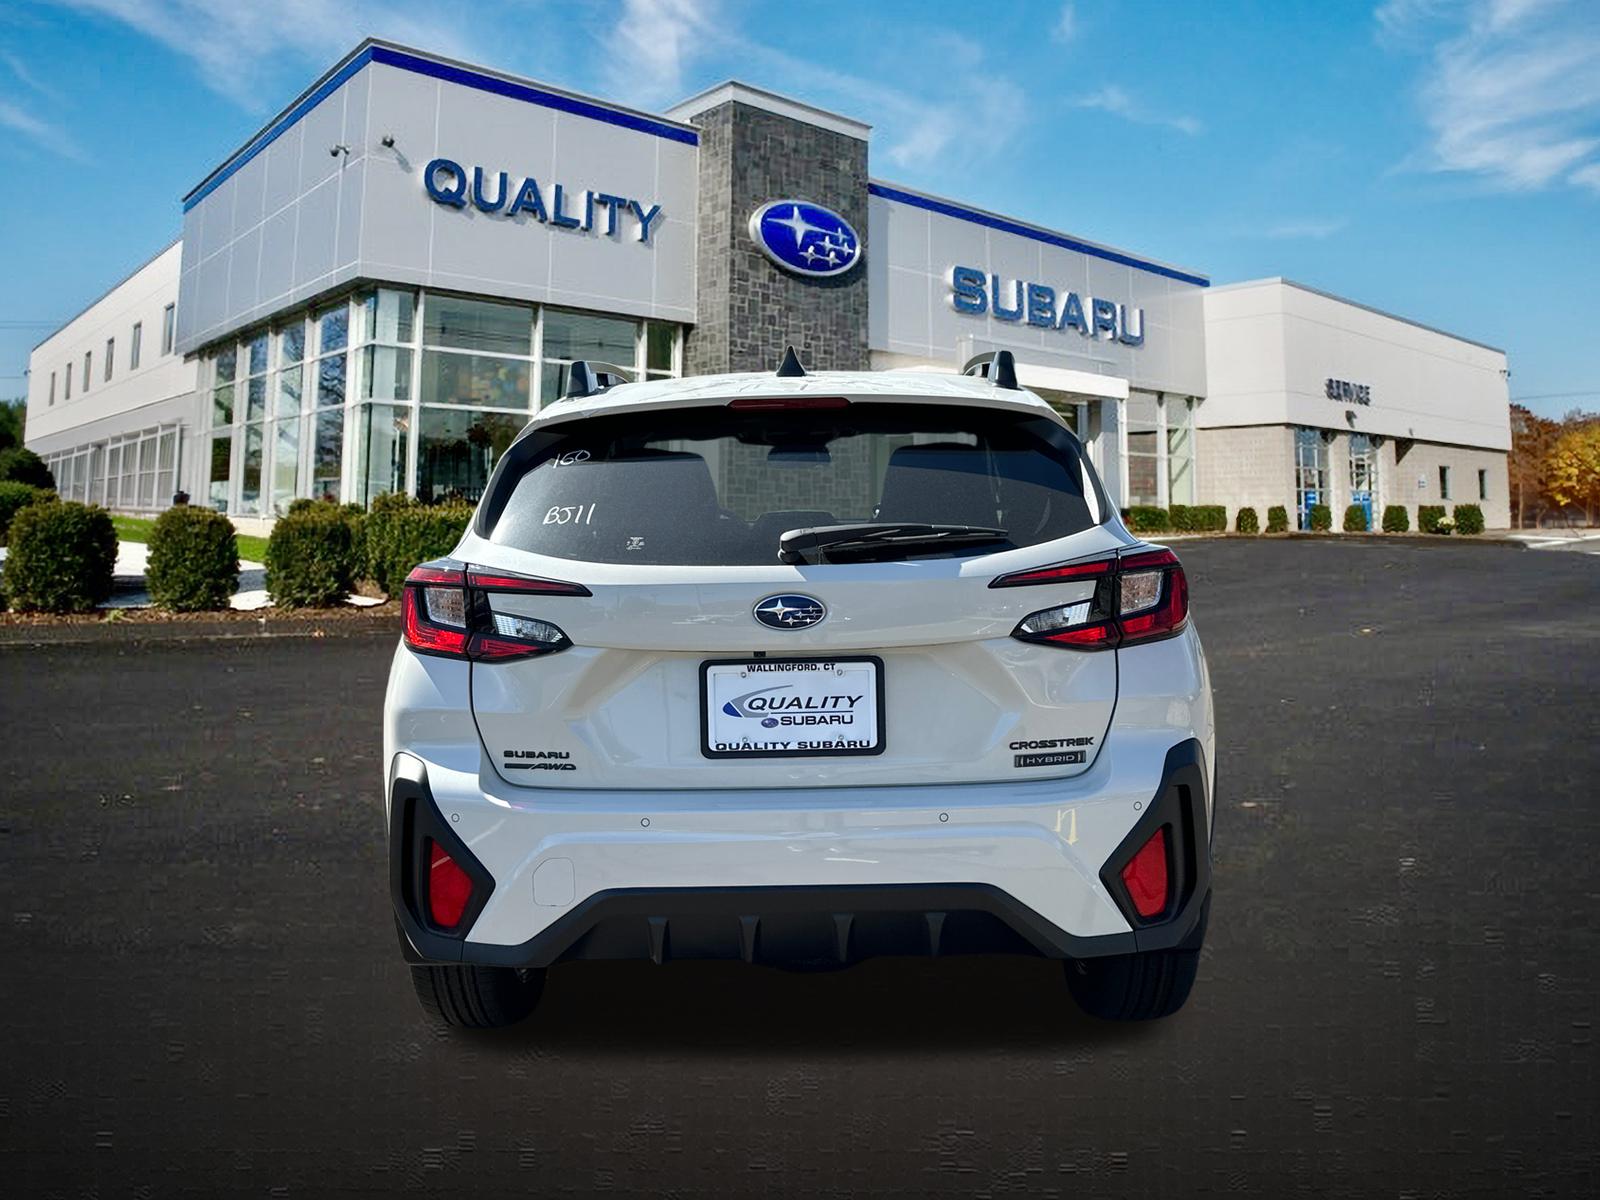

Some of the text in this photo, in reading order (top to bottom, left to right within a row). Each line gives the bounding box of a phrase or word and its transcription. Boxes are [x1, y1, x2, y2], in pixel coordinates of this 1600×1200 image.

[424, 158, 661, 243] QUALITY
[948, 265, 1145, 347] SUBARU
[552, 450, 591, 469] 160
[823, 663, 836, 671] CT
[747, 695, 864, 711] QUALITY
[780, 715, 854, 726] SUBARU
[715, 740, 871, 751] QUALITY SUBARU
[1009, 736, 1094, 750] CROSSTREK
[503, 750, 570, 759] SUBARU
[1026, 754, 1075, 764] HYBRID
